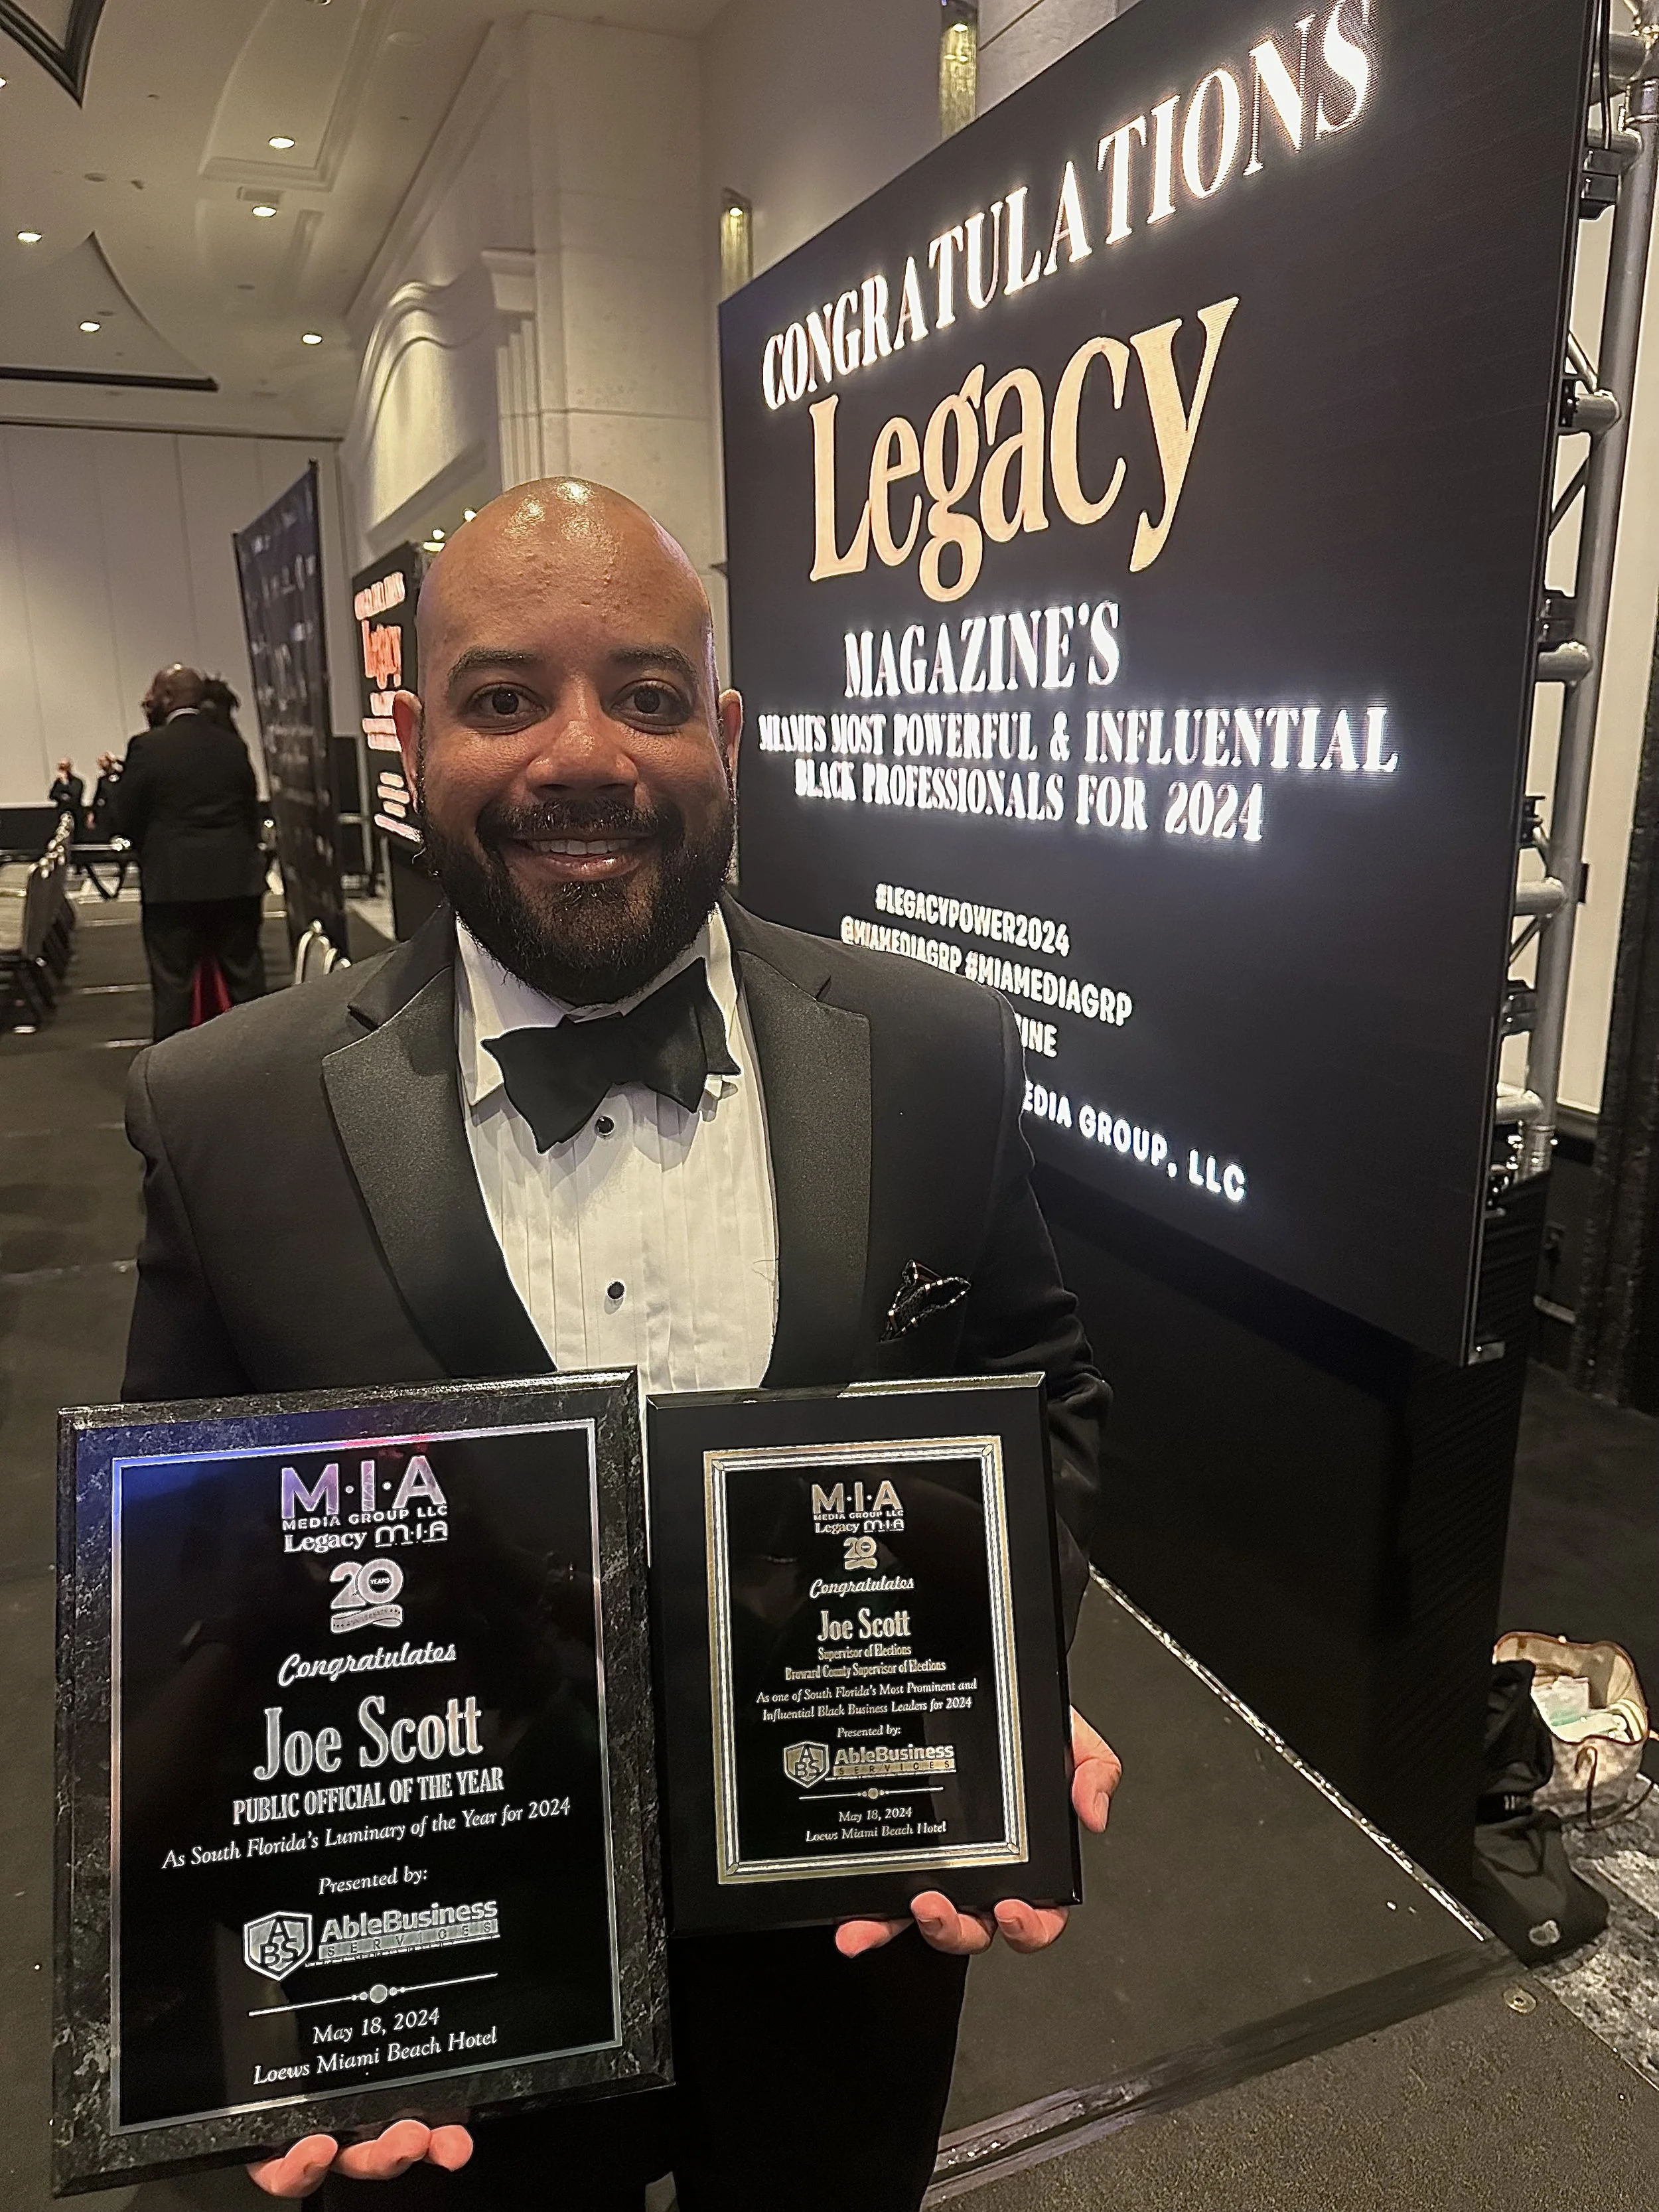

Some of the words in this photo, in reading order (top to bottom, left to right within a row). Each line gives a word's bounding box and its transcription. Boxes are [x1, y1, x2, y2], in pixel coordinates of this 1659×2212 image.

[762, 0, 1374, 409] CONGRATULATIONS
[810, 296, 1240, 602] Legacy
[843, 601, 1120, 698] MAGAZINE'S
[758, 713, 827, 753] MIAMI'S
[830, 713, 887, 756] MOST
[893, 712, 1038, 761] POWERFUL
[1049, 710, 1071, 762] &
[1084, 707, 1399, 774] INFLUENTIAL
[794, 759, 857, 802] BLACK
[862, 762, 1064, 823] PROFESSIONALS
[1076, 774, 1148, 832] FOR
[1164, 780, 1264, 842] 2024
[875, 883, 1071, 957] #LEGACYPOWER2024
[840, 915, 962, 974] @MIAMEDIAGRP
[965, 950, 1132, 1027] #MIAMEDIAGRP
[1015, 1012, 1058, 1058] INE
[1022, 1079, 1072, 1128] EDIA
[1078, 1104, 1177, 1179] GROUP,
[1189, 1148, 1246, 1203] LLC
[282, 1516, 341, 1531] MEDIA
[348, 1509, 409, 1524] GROUP
[416, 1505, 448, 1518] LLC
[815, 1522, 861, 1534] Legacy
[849, 1511, 883, 1519] GROUP
[283, 1530, 368, 1554] Legacy
[843, 1536, 877, 1559] 20
[330, 1558, 403, 1609] 20
[809, 1576, 914, 1599] Congratulates
[818, 1609, 853, 1641] Joe
[859, 1607, 912, 1639] Scott
[277, 1641, 458, 1687] Congratulates
[785, 1665, 821, 1680] Broward
[822, 1664, 851, 1678] County
[853, 1662, 897, 1677] Supervisor
[899, 1660, 908, 1673] of
[909, 1659, 947, 1672] Elections
[818, 1646, 863, 1661] Supervisor
[864, 1644, 874, 1657] of
[875, 1643, 912, 1657] Elections
[756, 1692, 770, 1704] As
[772, 1693, 789, 1702] one
[792, 1688, 803, 1703] of
[804, 1687, 833, 1701] South
[835, 1684, 877, 1698] Florida's
[879, 1683, 904, 1696] Most
[906, 1682, 956, 1694] Prominent
[958, 1678, 977, 1690] and
[762, 1706, 816, 1722] Influential
[818, 1704, 845, 1718] Black
[847, 1702, 888, 1716] Business
[891, 1700, 928, 1713] Leaders
[930, 1698, 944, 1712] for
[945, 1696, 972, 1710] 2024
[253, 1707, 342, 1781] Joe
[358, 1694, 484, 1768] Scott
[837, 1726, 884, 1738] Presented
[886, 1724, 901, 1736] by:
[834, 1743, 954, 1765] AbleBusiness
[838, 1760, 950, 1775] SERVICES
[232, 1792, 300, 1825] PUBLIC
[303, 1782, 386, 1816] OFFICIAL
[390, 1777, 414, 1805] OF
[416, 1772, 453, 1801] THE
[455, 1766, 505, 1795] YEAR
[161, 1849, 186, 1870] As
[190, 1840, 242, 1866] South
[246, 1829, 320, 1858] Florida's
[324, 1822, 405, 1848] Luminary
[410, 1815, 430, 1838] of
[431, 1813, 457, 1832] the
[462, 1807, 497, 1829] Year
[499, 1804, 524, 1826] for
[528, 1796, 571, 1819] 2024
[805, 1830, 839, 1842] Loews
[841, 1826, 879, 1840] Miami
[881, 1823, 914, 1836] Beach
[917, 1820, 947, 1834] Hotel
[838, 1810, 863, 1824] May
[866, 1809, 882, 1822] 18,
[885, 1806, 913, 1819] 2024
[319, 1866, 398, 1895] Presented
[403, 1865, 428, 1887] by:
[321, 1900, 498, 1943] AbleBusiness
[326, 1921, 492, 1957] SERVICES
[312, 2023, 354, 2045] May
[362, 2018, 387, 2037] 18,
[393, 2007, 440, 2031] 2024
[253, 2062, 311, 2085] Loews
[317, 2047, 380, 2074] Miami
[388, 2037, 441, 2063] Beach
[448, 2026, 498, 2051] Hotel
